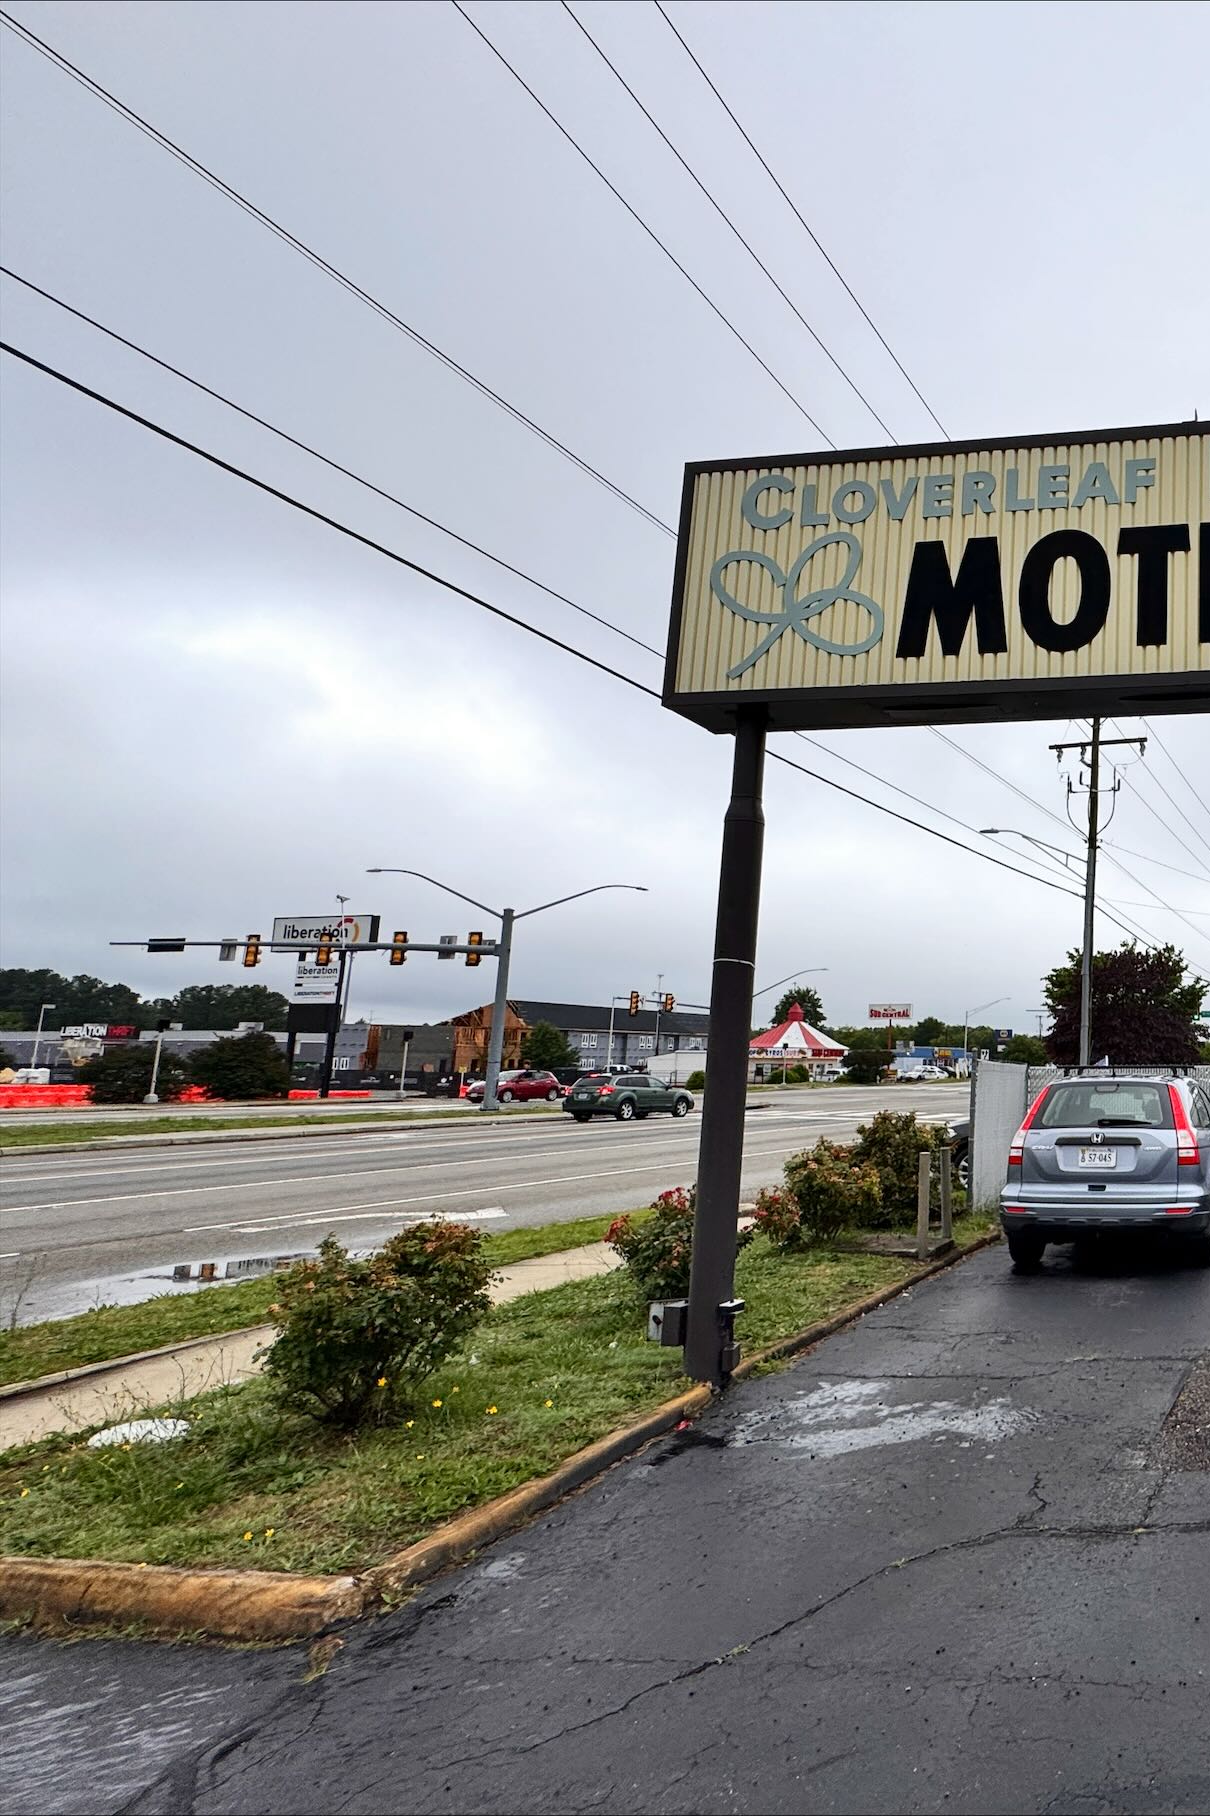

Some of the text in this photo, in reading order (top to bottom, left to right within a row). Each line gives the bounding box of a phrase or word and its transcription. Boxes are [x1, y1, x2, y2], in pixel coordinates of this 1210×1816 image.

[741, 457, 1156, 531] CLOVERLEAF
[283, 924, 349, 939] liberation
[297, 966, 338, 975] liberation
[870, 1008, 910, 1018] SUB CENTRAL
[60, 1024, 108, 1037] LIBERATION
